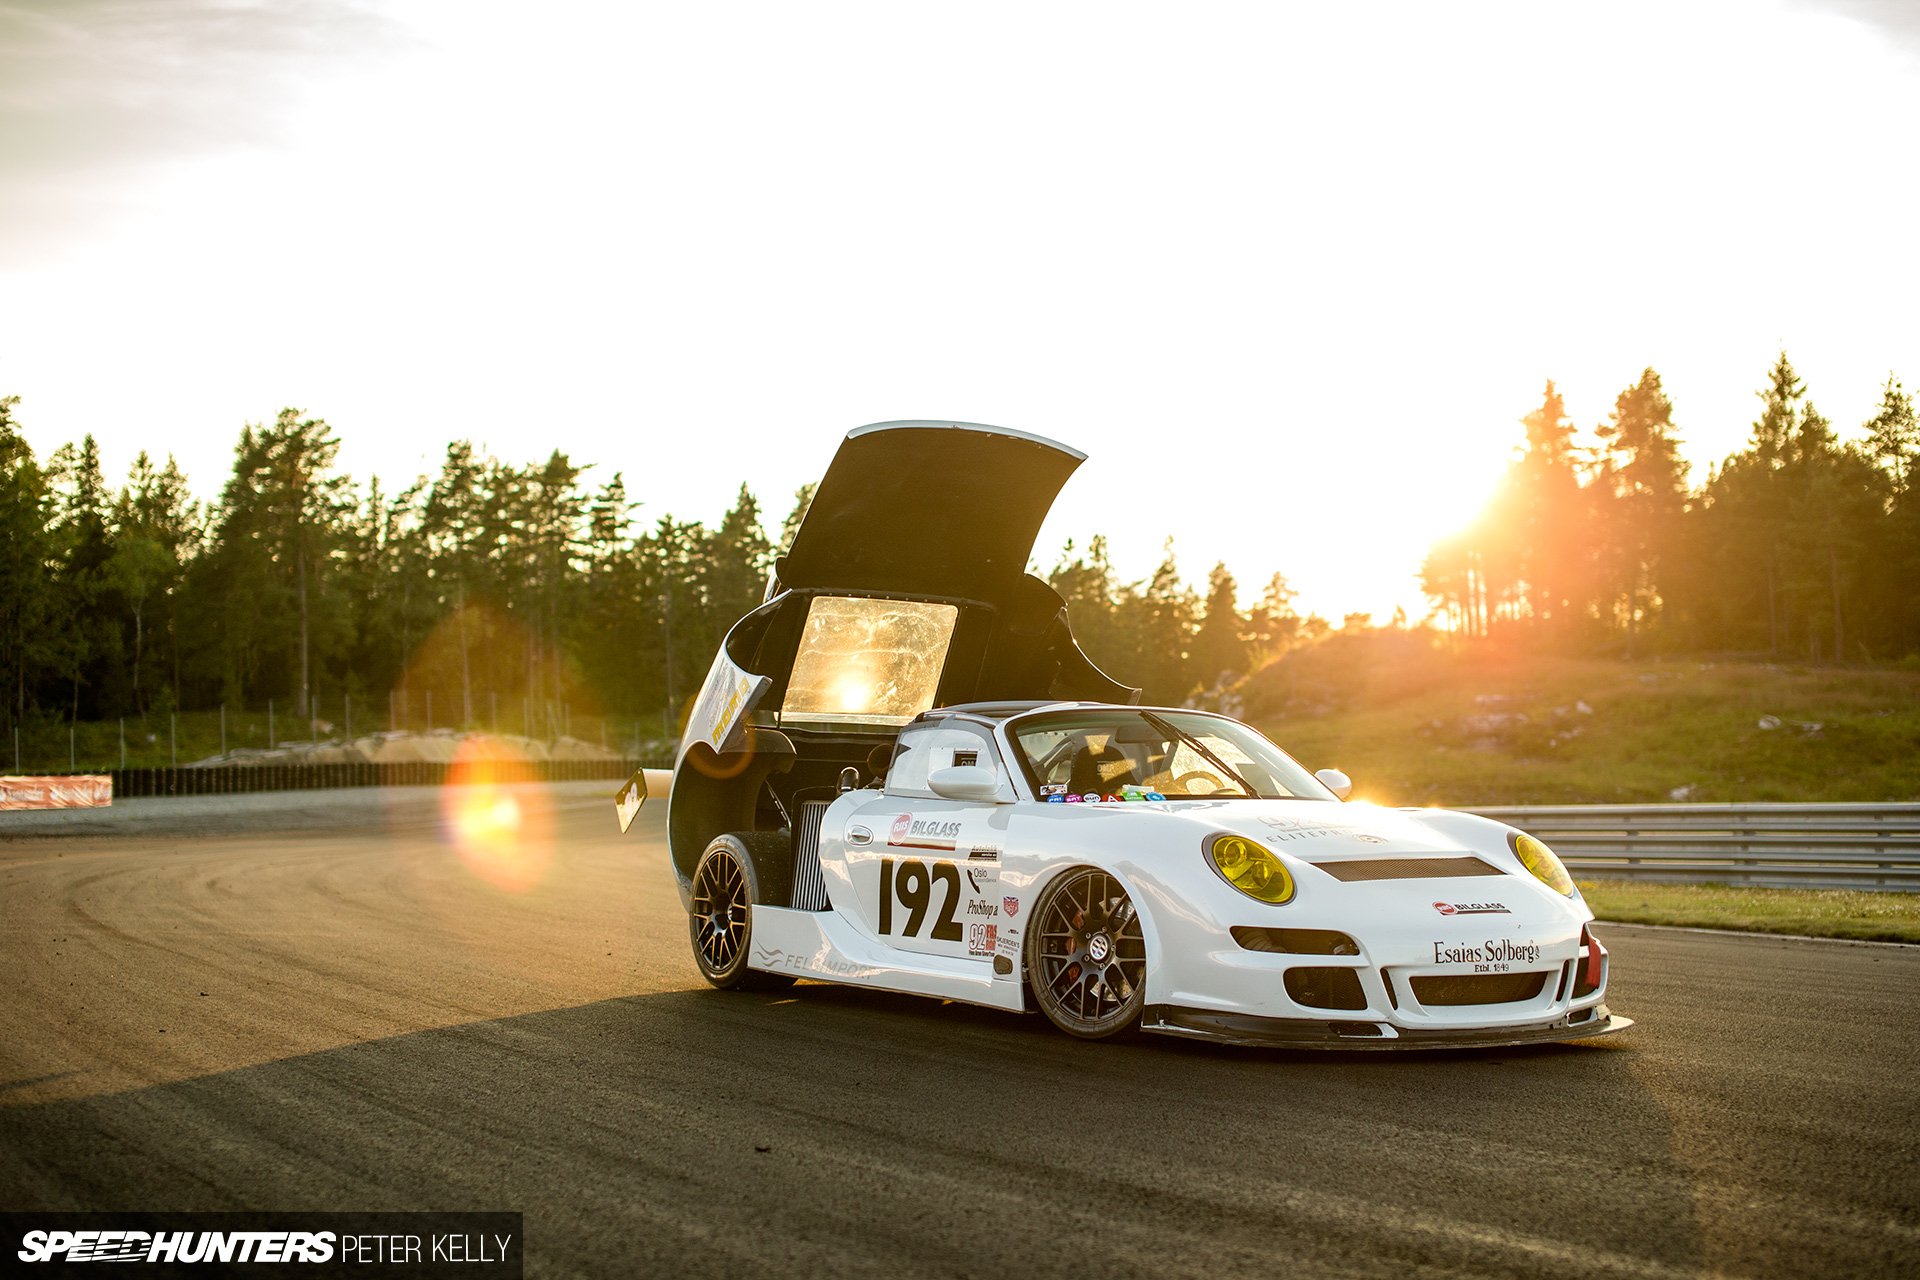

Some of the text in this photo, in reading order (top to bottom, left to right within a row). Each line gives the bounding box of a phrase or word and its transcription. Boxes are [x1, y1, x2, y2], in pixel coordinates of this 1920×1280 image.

[910, 820, 962, 838] BILGLASS
[878, 858, 963, 942] 192
[1454, 902, 1506, 910] BILGLASS
[969, 923, 986, 951] 92
[1433, 940, 1482, 964] Esaias
[1484, 938, 1534, 964] Solberg
